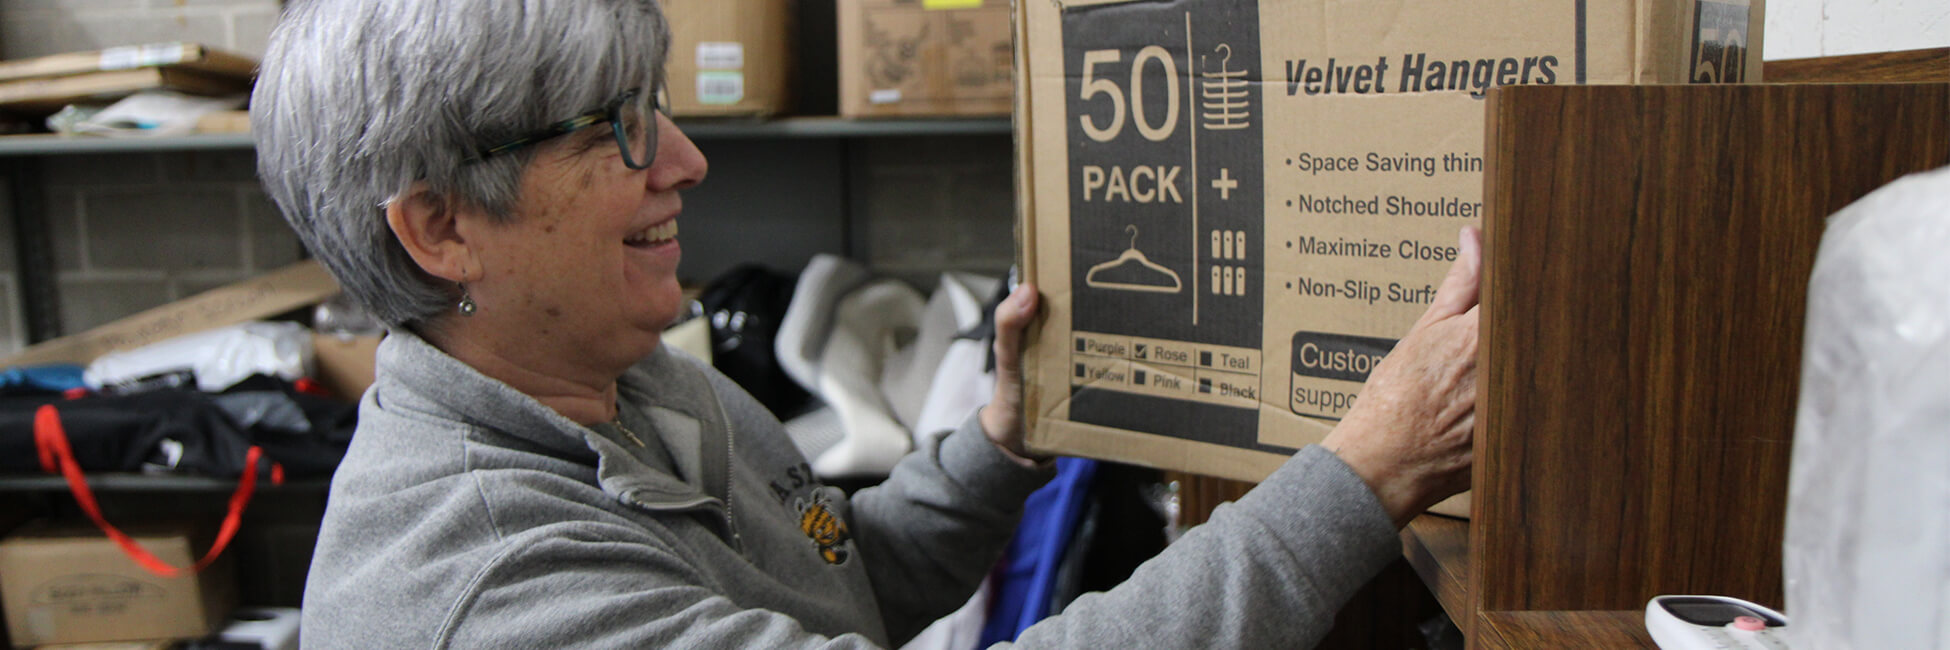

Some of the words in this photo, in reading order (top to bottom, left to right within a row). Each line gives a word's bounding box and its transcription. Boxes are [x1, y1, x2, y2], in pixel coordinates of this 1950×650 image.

[1285, 57, 1388, 96] Velvet
[1399, 53, 1558, 99] Hangers
[1080, 45, 1180, 142] 50
[1298, 153, 1359, 175] Space
[1366, 153, 1436, 177] Saving
[1443, 153, 1483, 172] thin
[1083, 165, 1183, 203] PACK
[1299, 194, 1379, 215] Notched
[1386, 196, 1482, 217] Shoulder
[1299, 236, 1392, 258] Maximize
[1399, 240, 1461, 262] Close
[1299, 277, 1381, 305] Non-Slip
[1088, 338, 1125, 356] Purple
[1154, 346, 1188, 362] Rose
[1221, 353, 1250, 369] Teal
[1088, 366, 1125, 383] Yellow
[1153, 374, 1181, 389] Pink
[1219, 383, 1256, 400] Black
